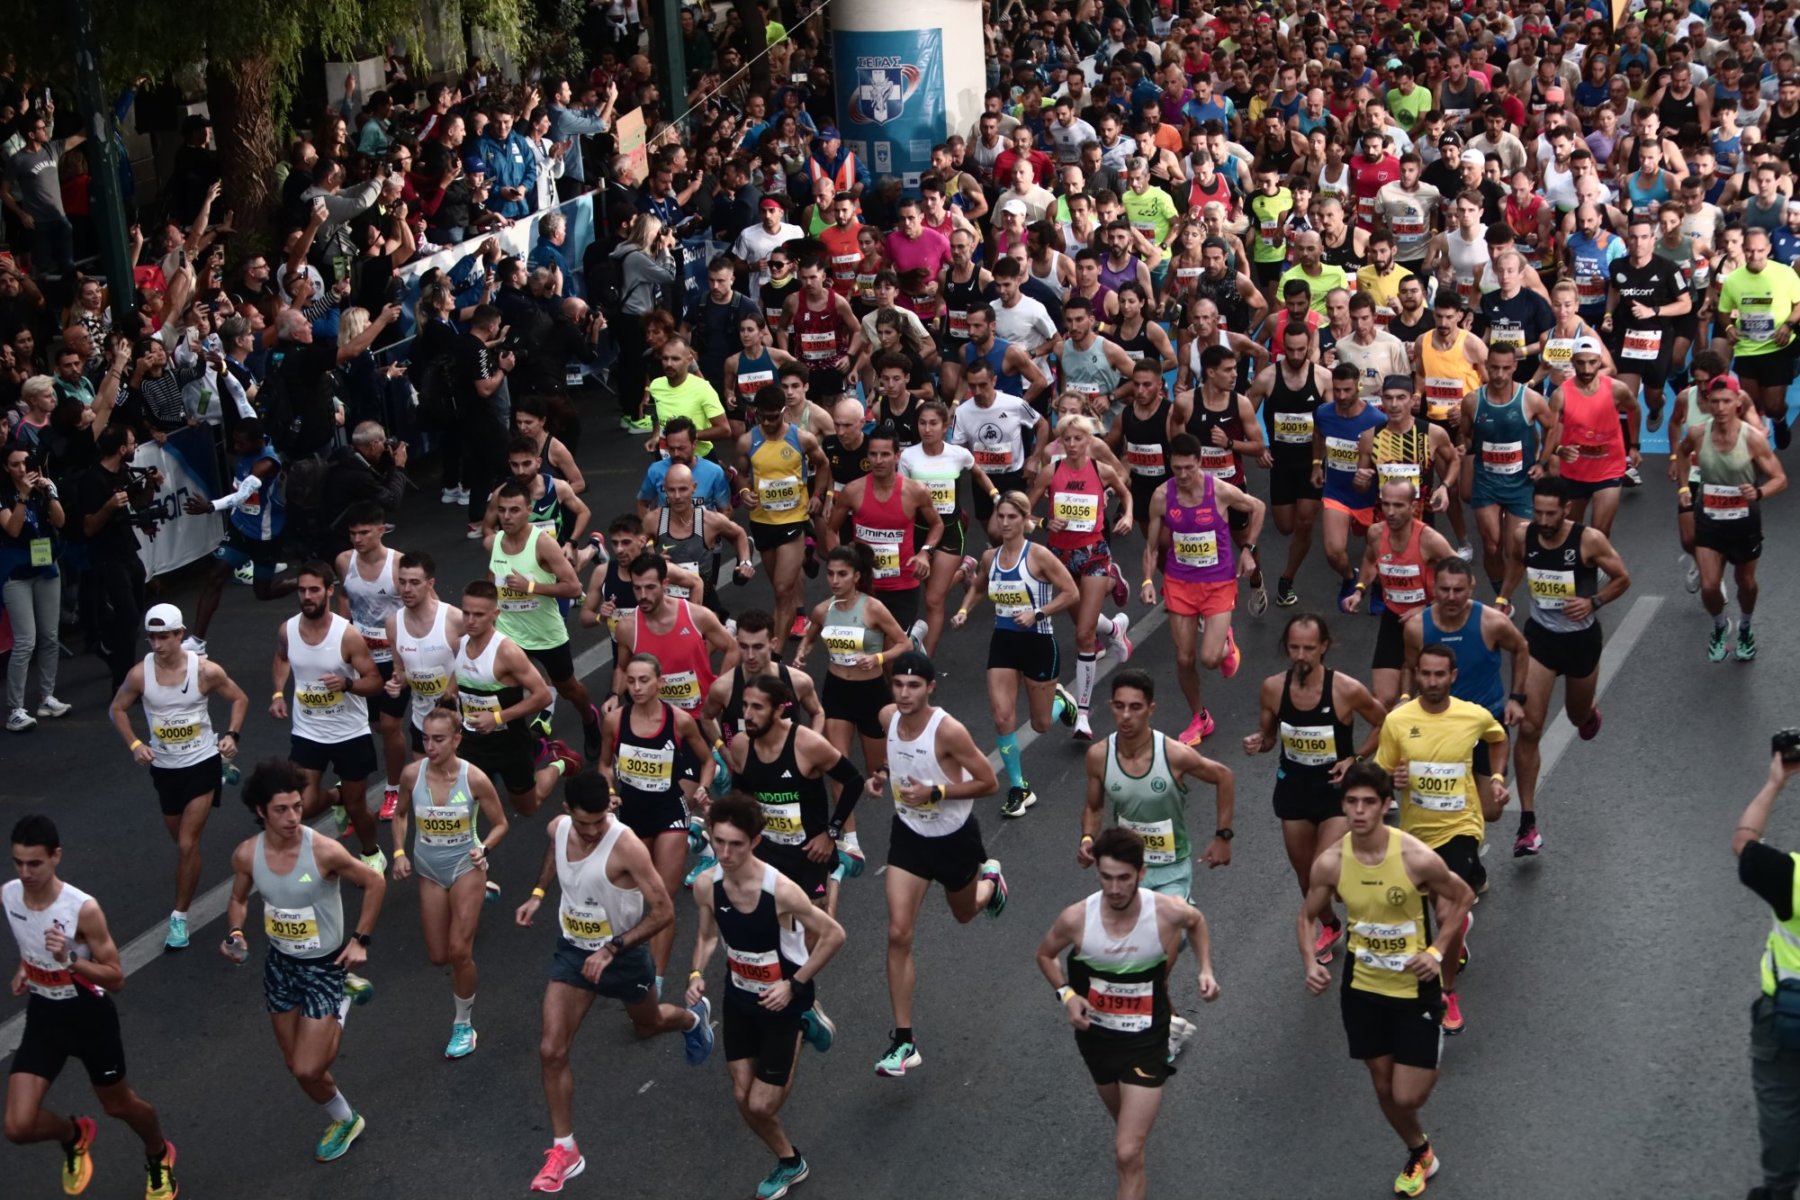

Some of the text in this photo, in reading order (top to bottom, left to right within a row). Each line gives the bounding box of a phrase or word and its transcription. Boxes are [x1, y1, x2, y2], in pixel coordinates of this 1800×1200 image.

[856, 56, 901, 68] ΣΕΓΑΣ
[1548, 348, 1571, 357] 30225
[1281, 422, 1307, 431] 30019
[979, 453, 1005, 463] 31006
[1332, 449, 1357, 459] 30027
[1066, 481, 1086, 490] NIKE
[765, 489, 793, 499] 30166
[1060, 505, 1090, 516] 30356
[864, 530, 904, 540] MINAS
[1179, 543, 1210, 554] 30012
[1534, 581, 1567, 594] 30164
[995, 593, 1022, 604] 30355
[827, 638, 856, 650] 30360
[412, 680, 442, 693] 30001
[659, 684, 691, 696] 30029
[303, 691, 335, 703] 30015
[160, 726, 194, 739] 30008
[1289, 737, 1326, 750] 30160
[627, 759, 663, 774] 30351
[1418, 776, 1457, 791] 30017
[424, 818, 461, 831] 30354
[767, 816, 793, 829] 0151
[271, 920, 307, 935] 30152
[566, 917, 601, 932] 30169
[1365, 936, 1407, 951] 30159
[1097, 995, 1142, 1011] 31917
